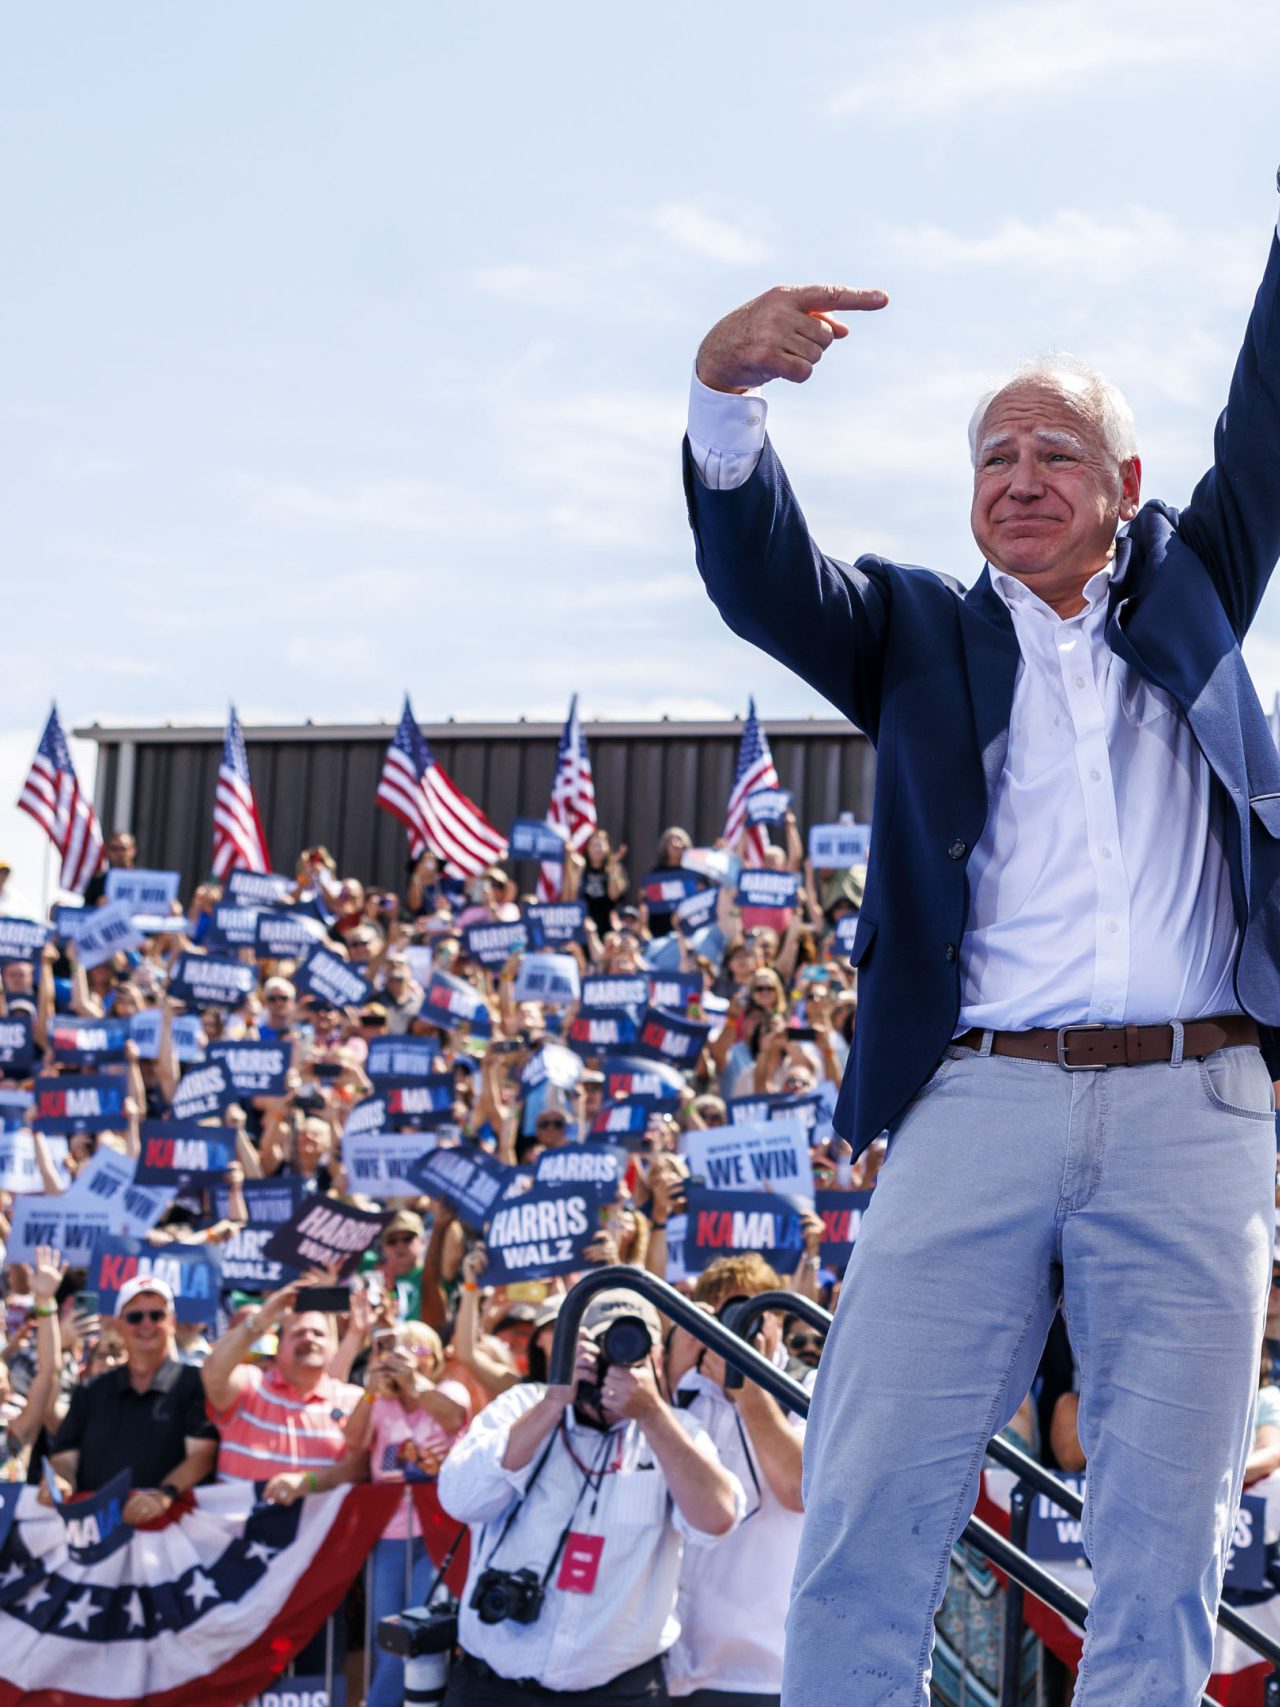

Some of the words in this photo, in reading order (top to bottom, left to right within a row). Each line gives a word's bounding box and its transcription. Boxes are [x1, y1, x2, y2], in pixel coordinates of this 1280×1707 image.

[145, 1137, 230, 1172] KAMALA
[537, 1153, 618, 1183] HARRIS
[706, 1153, 746, 1187] WE
[750, 1148, 798, 1181] WIN
[24, 1221, 58, 1247] WE
[488, 1196, 589, 1248] HARRIS
[696, 1210, 802, 1249] KAMALA
[221, 1261, 283, 1281] WALZ
[502, 1238, 575, 1270] WALZ
[99, 1253, 212, 1300] KAMALA
